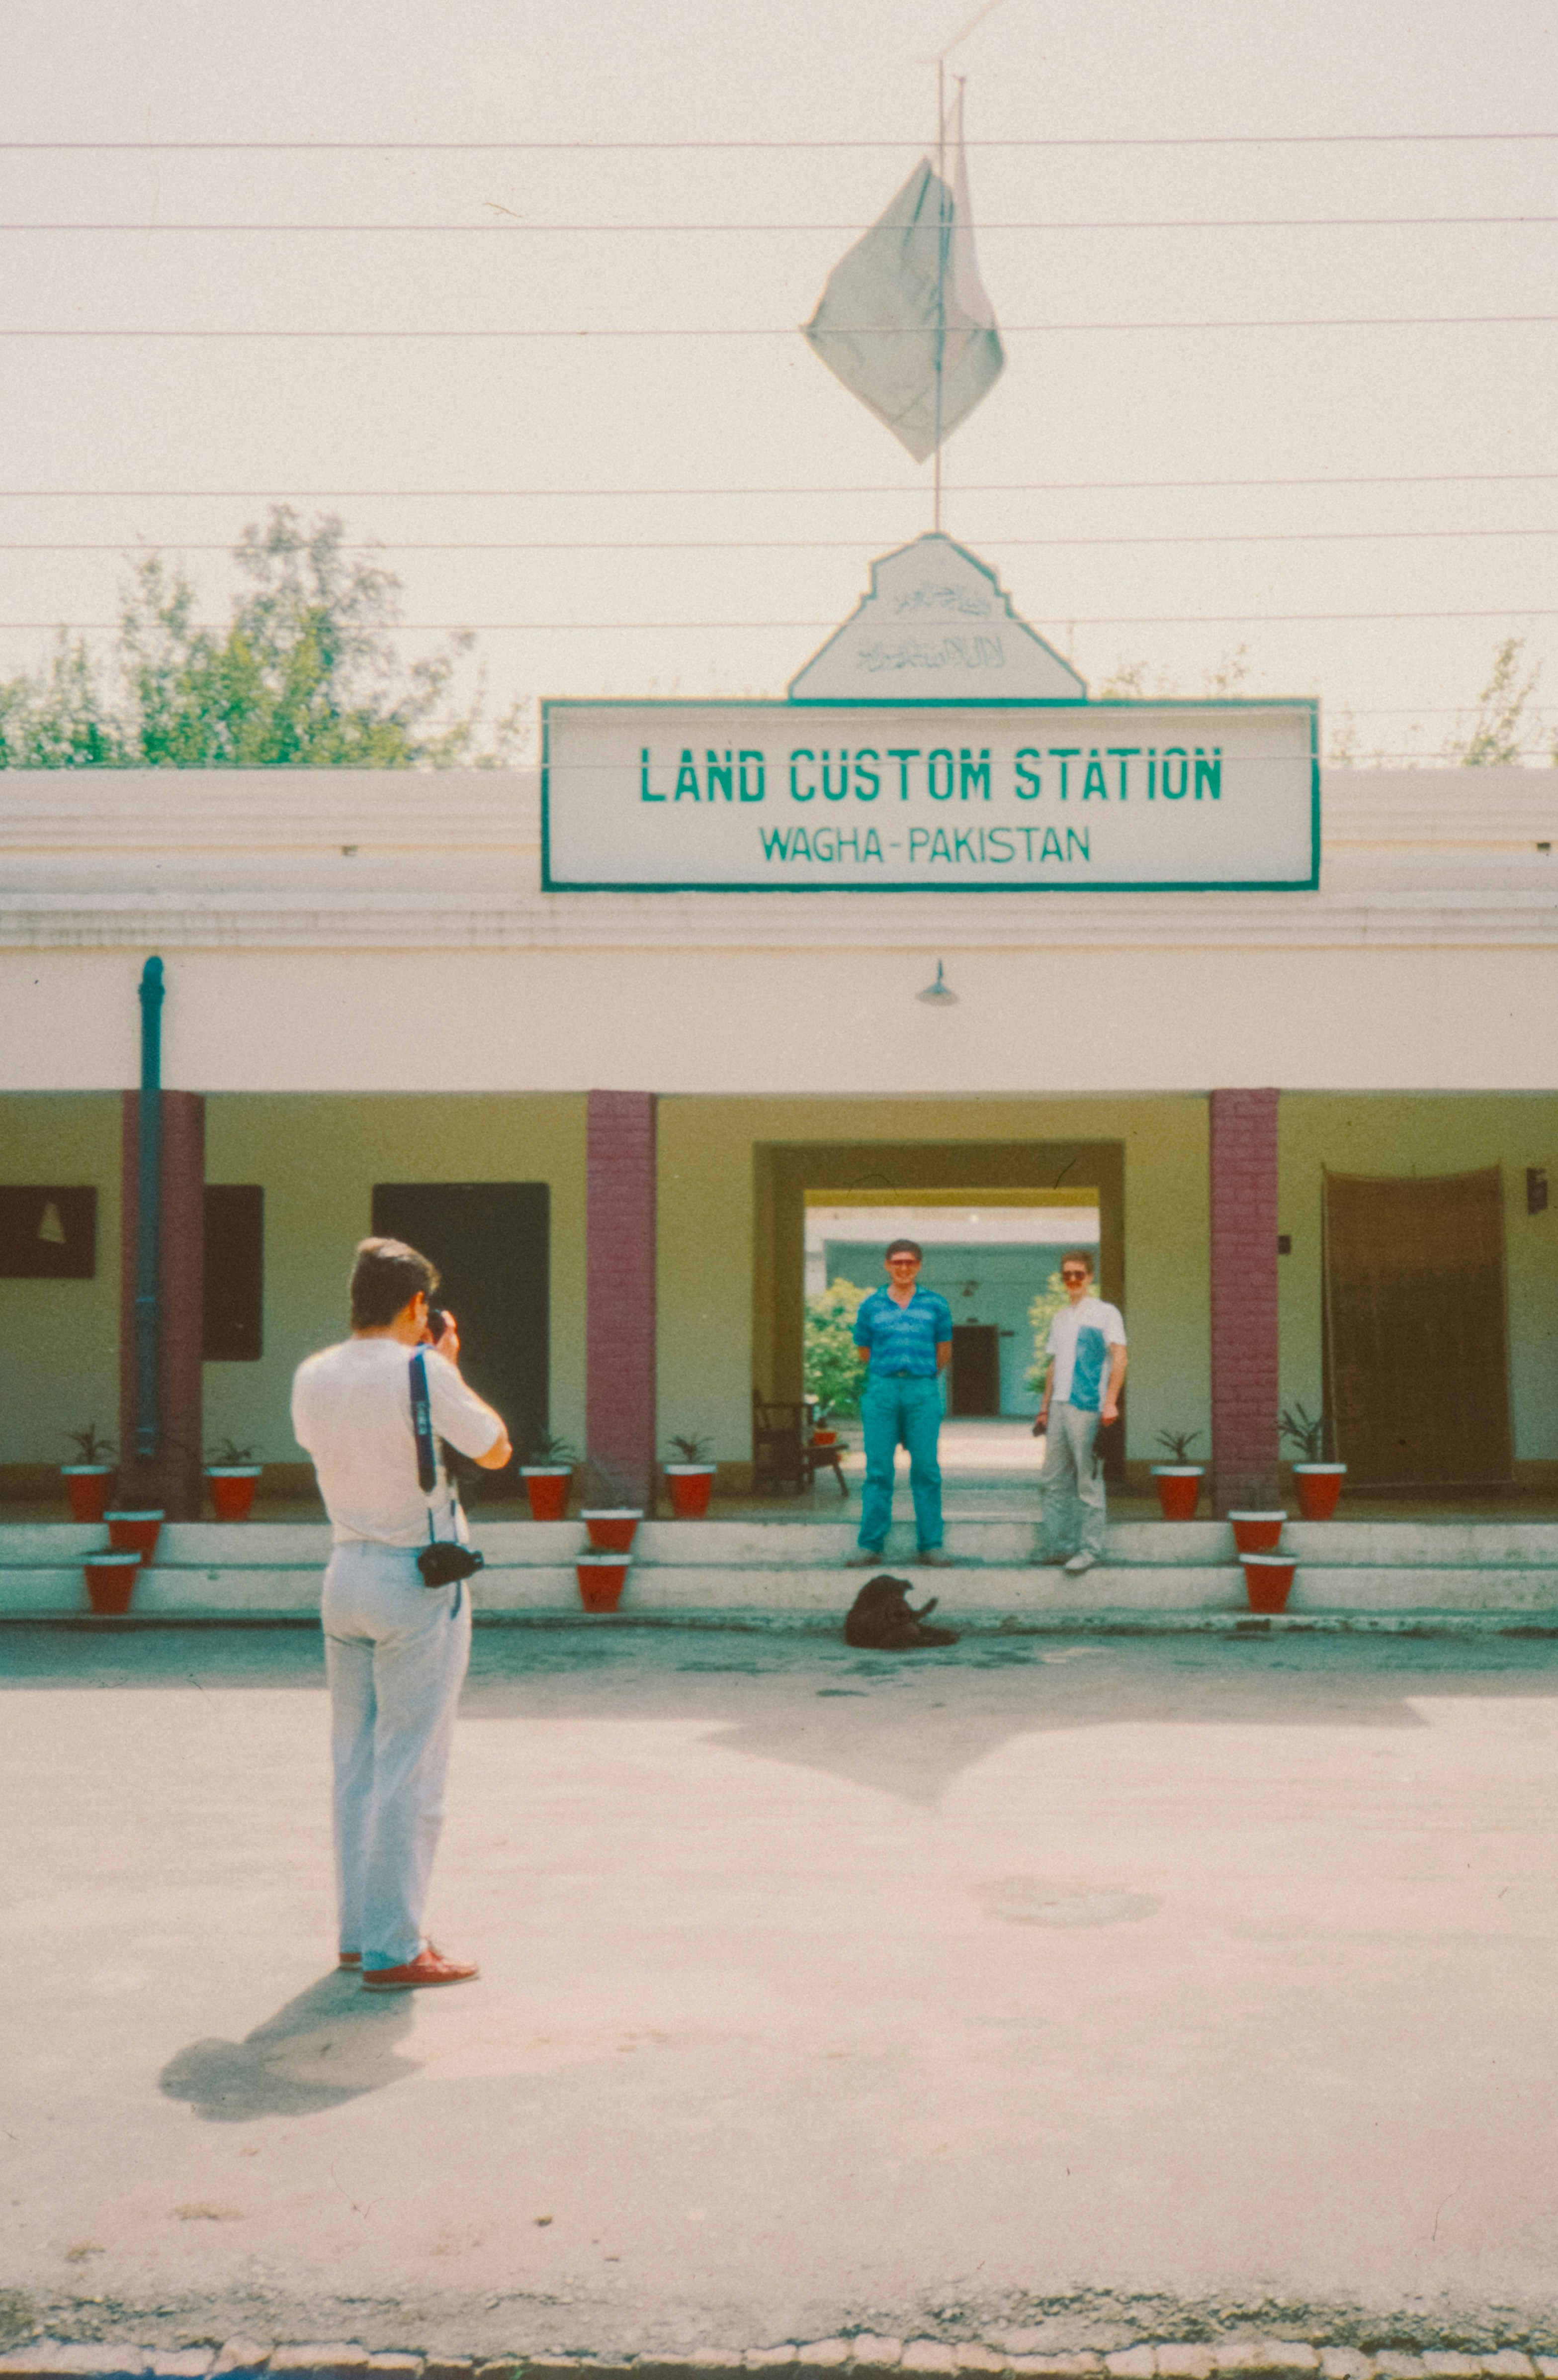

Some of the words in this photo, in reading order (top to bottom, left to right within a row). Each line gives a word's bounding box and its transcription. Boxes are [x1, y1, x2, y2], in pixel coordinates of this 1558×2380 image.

[640, 747, 767, 803] LAND
[788, 747, 992, 803] CUSTOM
[1014, 746, 1222, 801] STATION
